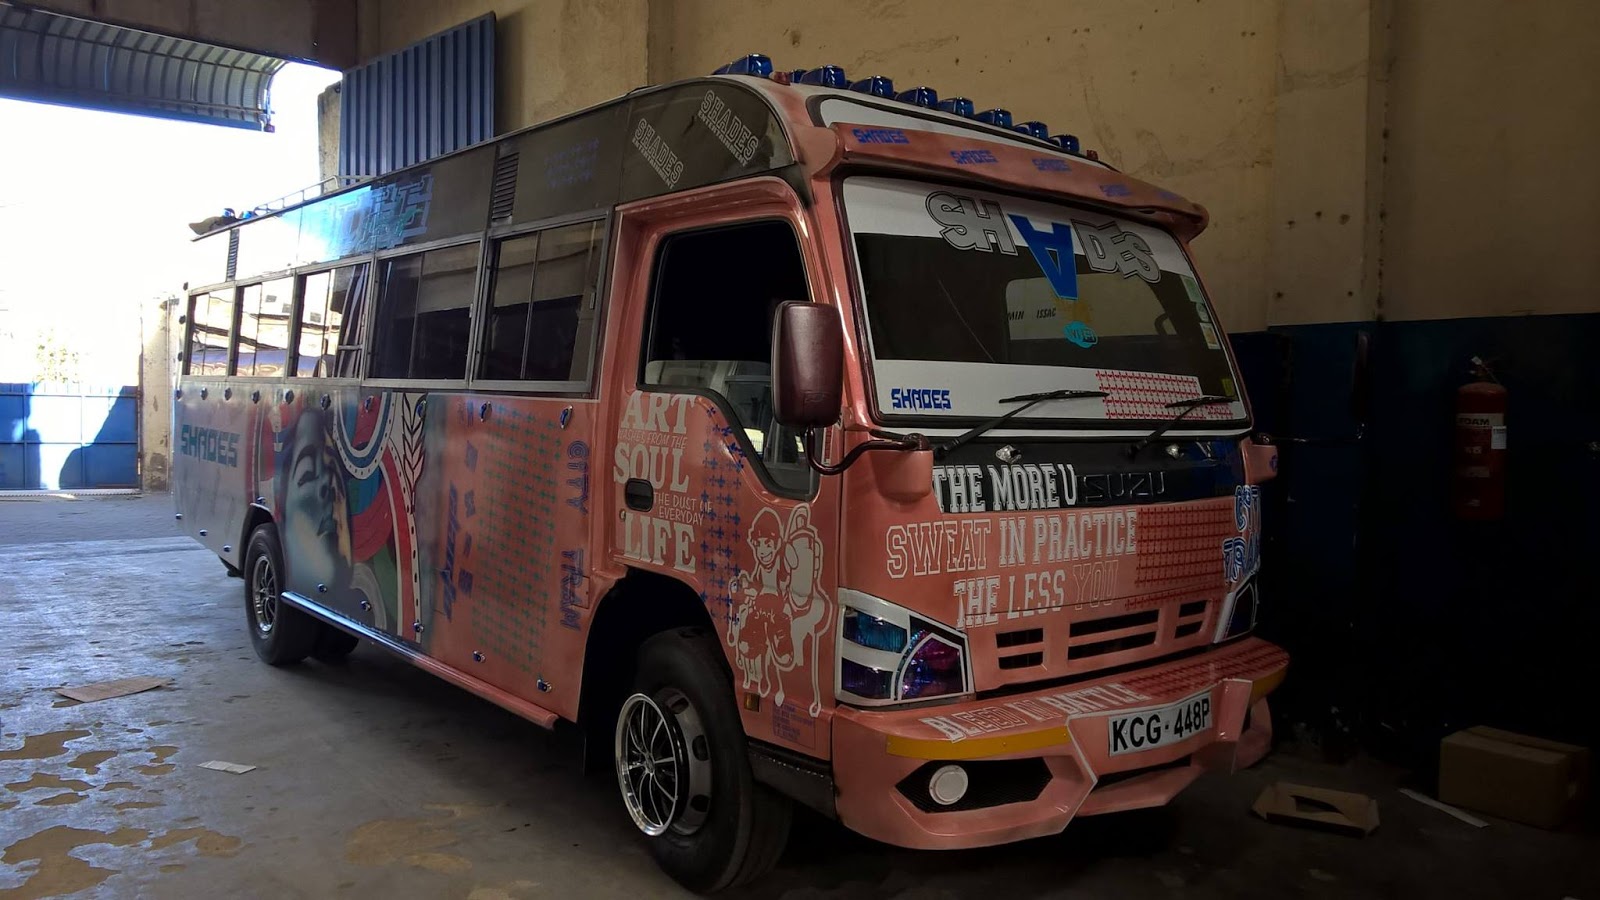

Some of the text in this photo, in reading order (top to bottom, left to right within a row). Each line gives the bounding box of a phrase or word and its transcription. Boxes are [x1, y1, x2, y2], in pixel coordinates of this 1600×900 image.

[634, 118, 684, 184] SHADES
[697, 110, 748, 167] ENTERTAINMENT
[700, 89, 759, 161] SHADES
[852, 128, 910, 145] SHADES
[925, 190, 1162, 301] SHADES
[620, 389, 697, 435] ART
[891, 387, 952, 412] SHADES
[180, 424, 241, 468] SHADES
[647, 431, 670, 446] FROM
[671, 435, 688, 450] THE
[613, 442, 690, 493] SOUL
[932, 462, 1079, 514] THE MORE U
[653, 491, 670, 507] THE
[672, 494, 697, 512] DUST
[658, 505, 705, 526] EVERYDAY
[623, 511, 697, 574] LIFE
[886, 508, 1138, 579] SWEAT IN PRACTICE
[953, 560, 1120, 631] THE LESS YOU
[917, 706, 1029, 744] BLEED
[1038, 682, 1154, 715] BATTLE
[1112, 698, 1211, 753] KCG 448P
